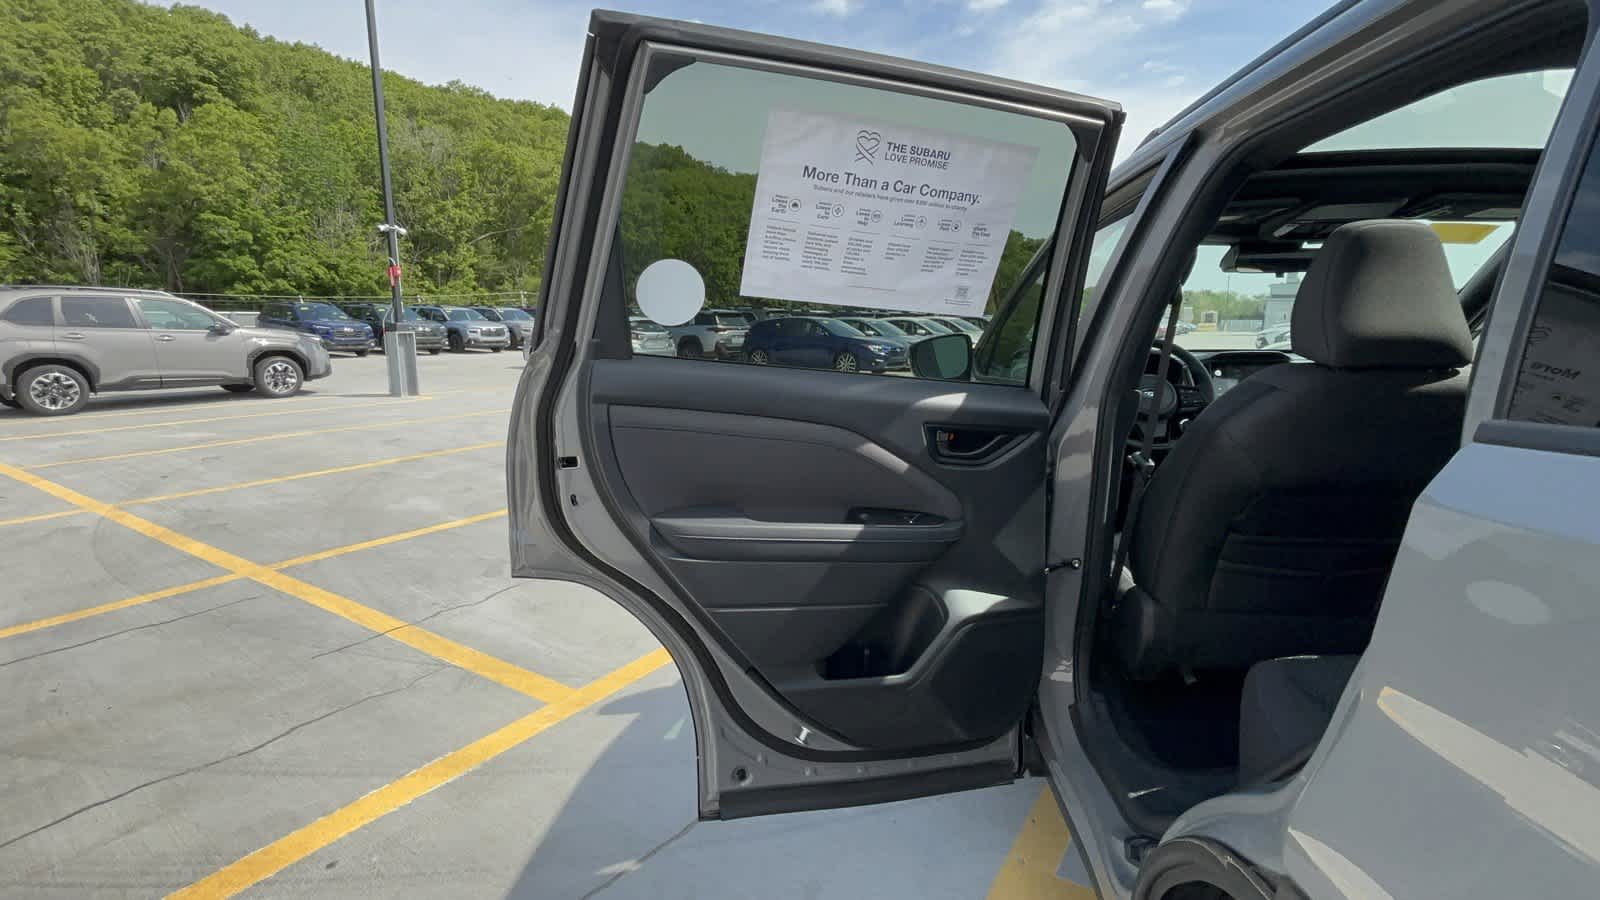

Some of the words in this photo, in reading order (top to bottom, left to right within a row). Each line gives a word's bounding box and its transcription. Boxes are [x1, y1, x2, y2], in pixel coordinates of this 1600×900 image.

[884, 152, 909, 164] LOVE
[908, 156, 950, 170] PROMISE
[886, 141, 908, 154] THE
[909, 145, 952, 161] SUBARU
[802, 165, 840, 183] More
[844, 171, 878, 190] Than
[881, 180, 890, 191] a
[893, 179, 917, 195] Car
